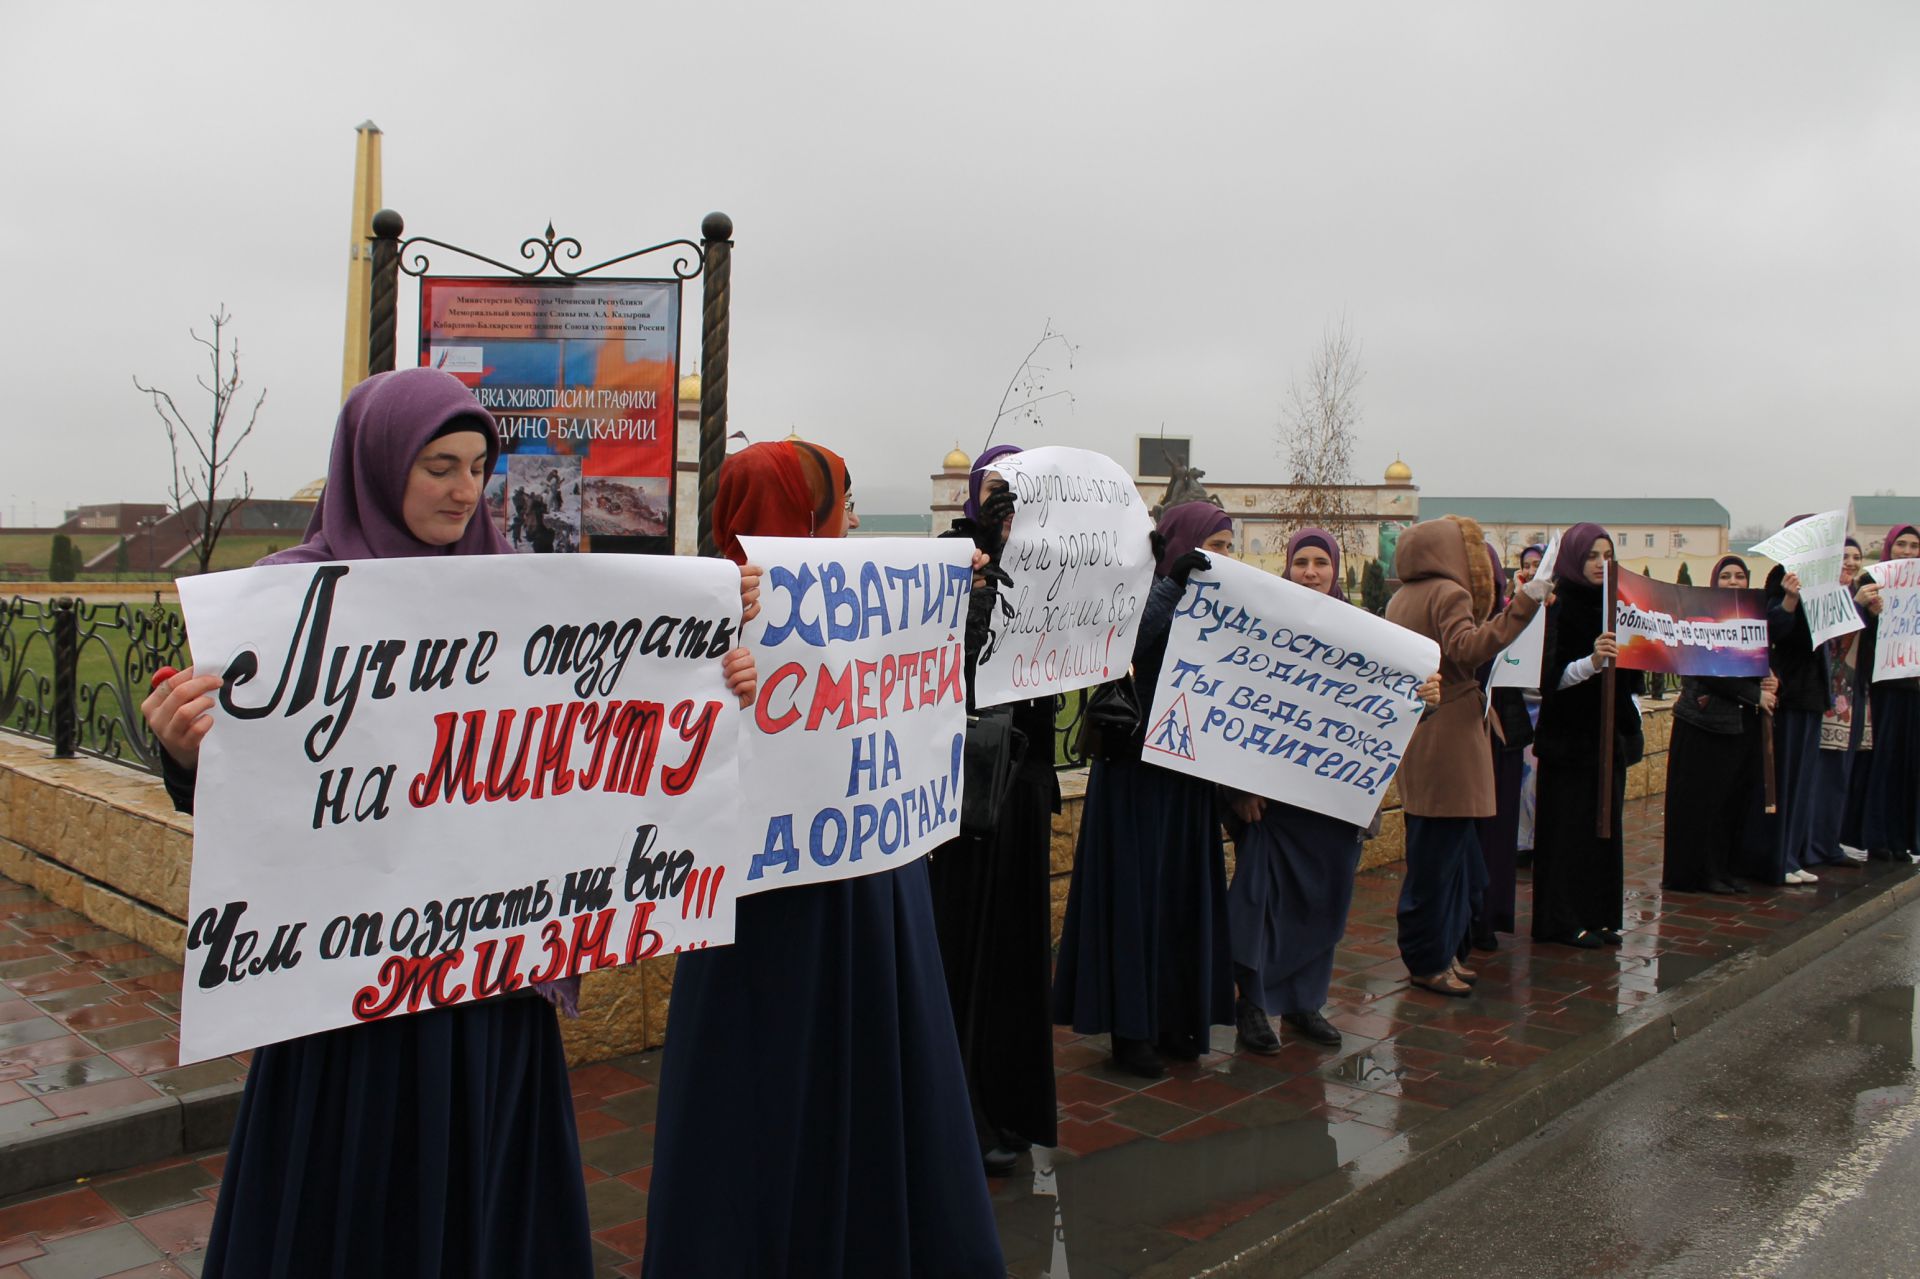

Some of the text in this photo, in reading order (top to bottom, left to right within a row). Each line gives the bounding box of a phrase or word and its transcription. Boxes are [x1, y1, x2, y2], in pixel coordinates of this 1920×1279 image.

[448, 308, 510, 317] Мемориальный
[597, 297, 644, 307] Республики
[638, 323, 665, 332] России
[498, 416, 657, 445] ДИНО-БАЛКАРИИ
[506, 387, 583, 409] ЖИВОПИСИ
[585, 389, 595, 409] И
[597, 389, 657, 410] ГРАФИКИ
[760, 560, 974, 647] ХВАТИТ
[1694, 627, 1738, 645] случится
[218, 565, 734, 764] Лучше опоздать
[754, 633, 964, 735] СМЕРТЕЙ
[312, 763, 398, 830] на
[845, 729, 903, 798] НА
[746, 732, 964, 881] ДОРОГАХ!
[186, 900, 308, 990] Чем
[319, 878, 554, 960] опоздать
[559, 865, 616, 918] на
